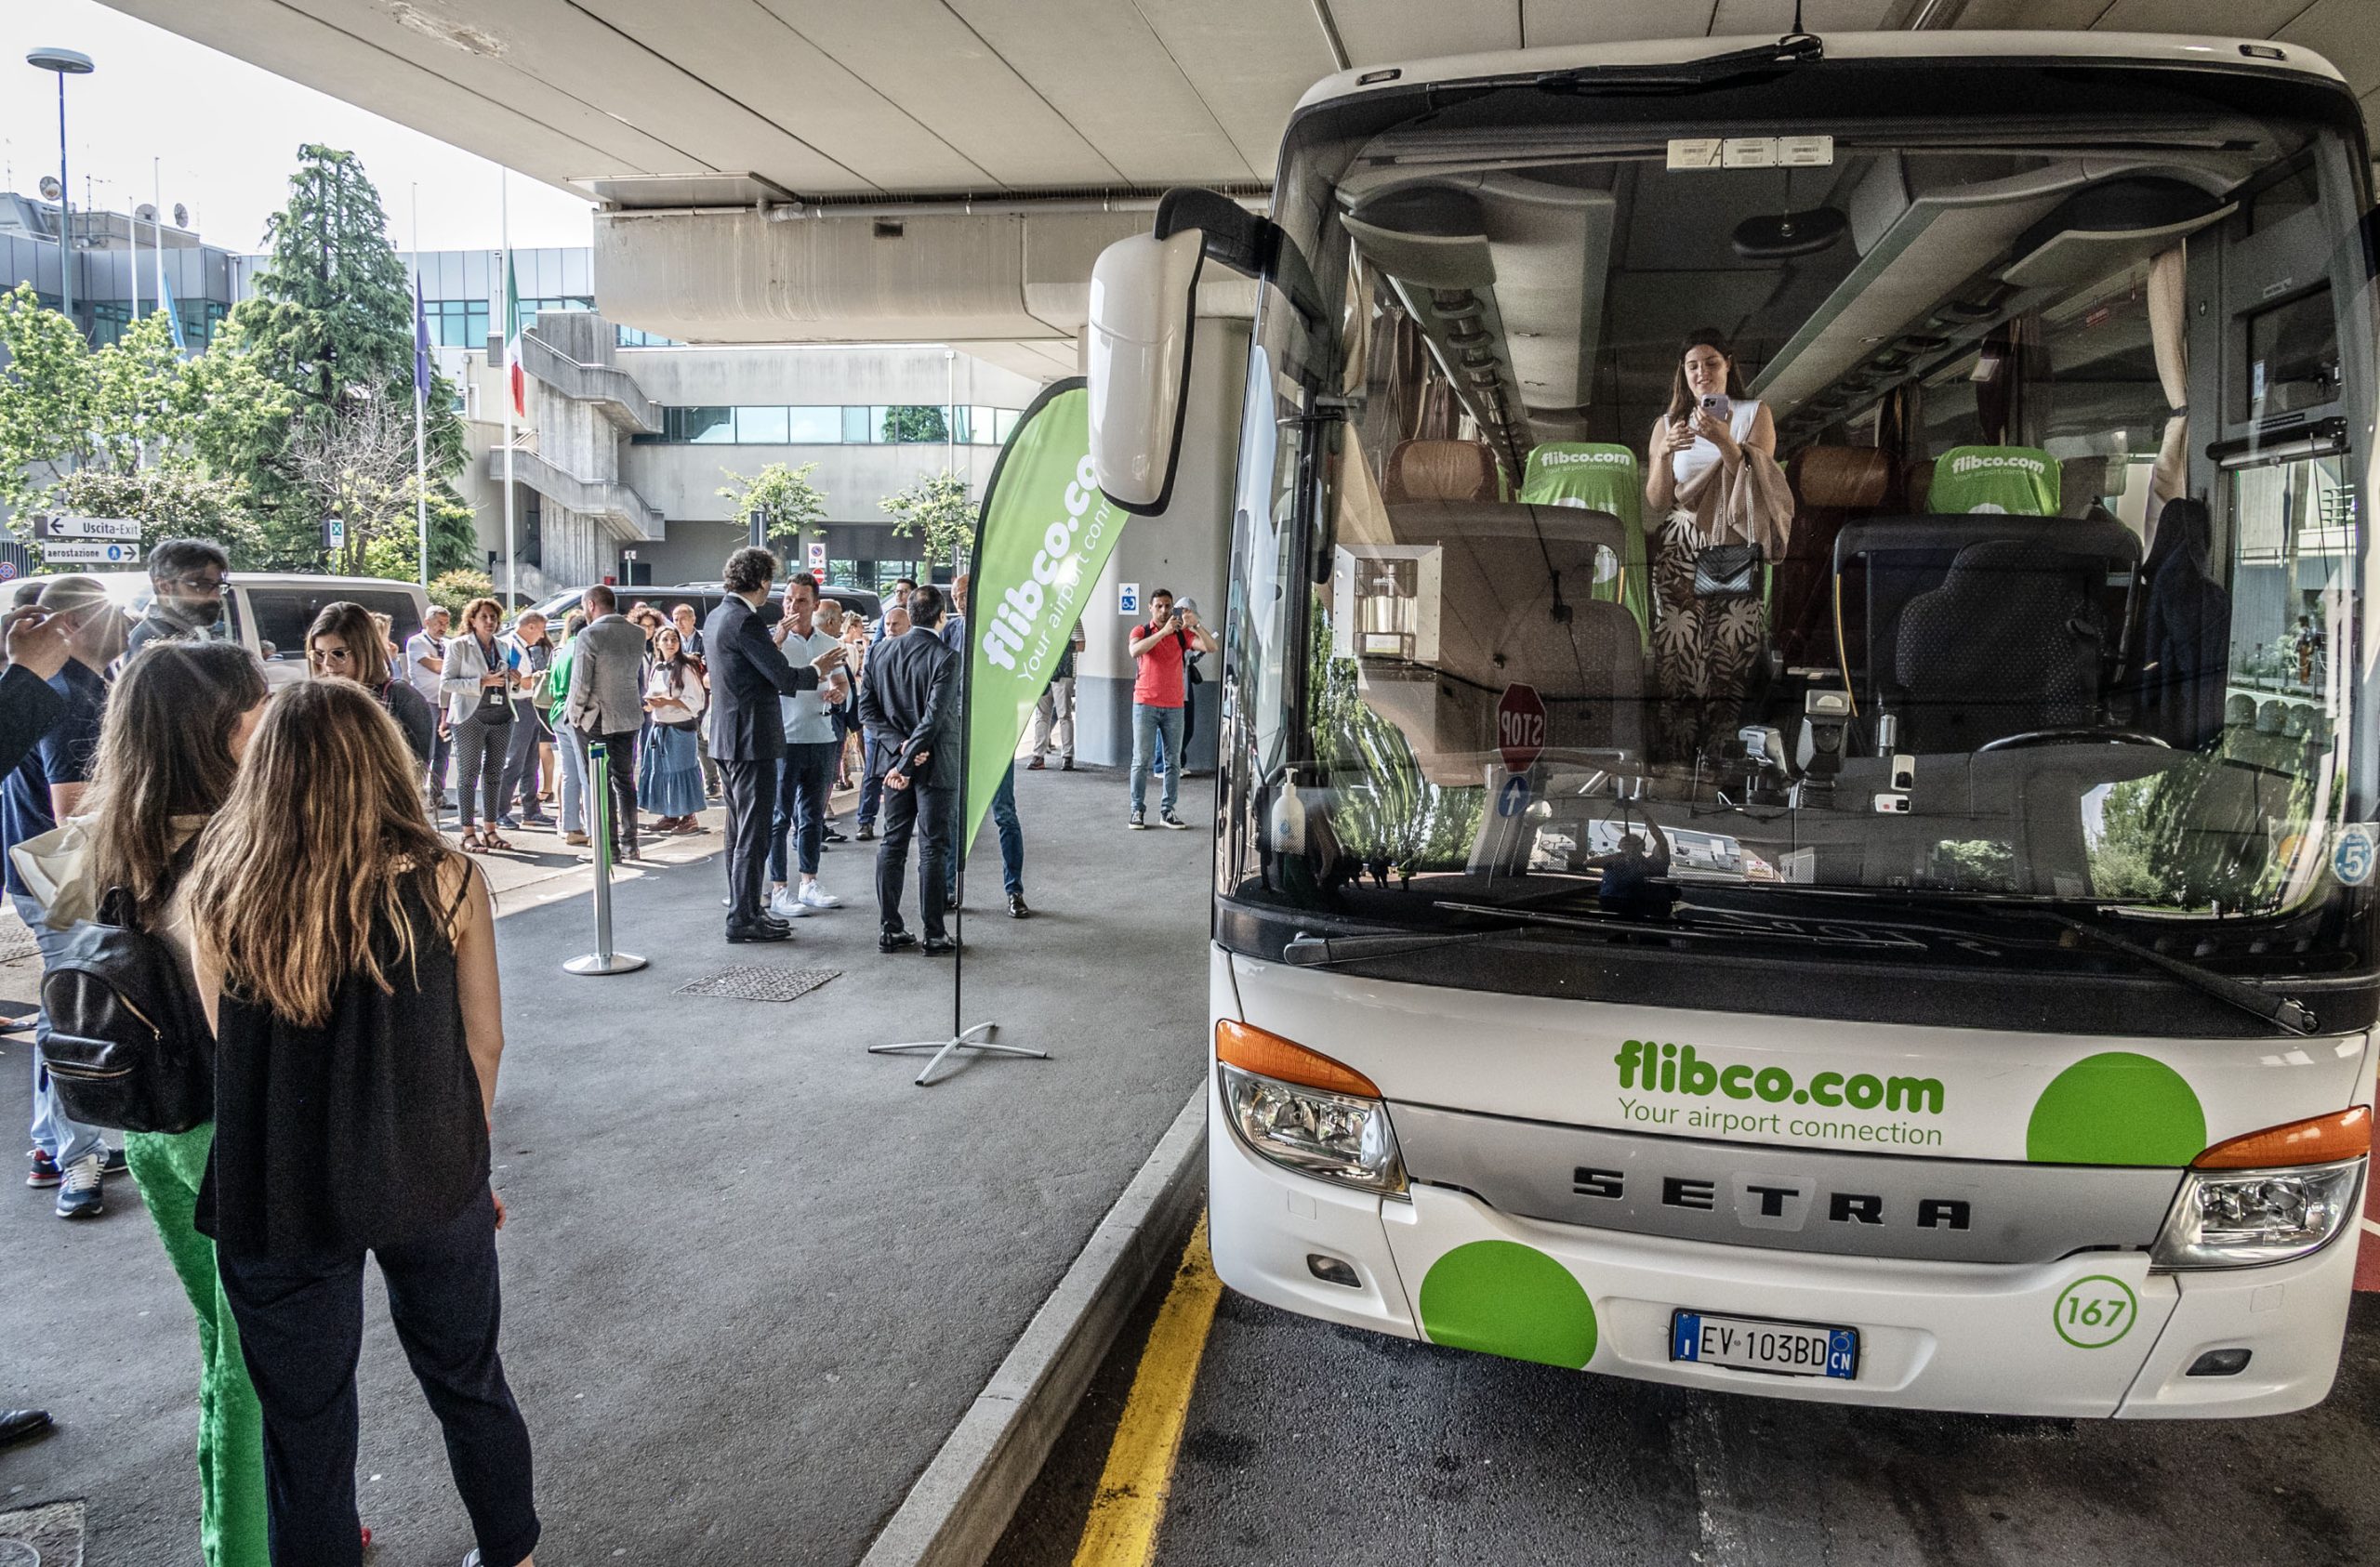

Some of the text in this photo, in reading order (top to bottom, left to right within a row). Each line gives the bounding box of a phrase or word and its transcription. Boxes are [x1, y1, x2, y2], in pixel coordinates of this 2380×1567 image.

[1540, 451, 1631, 467] flibco.com
[1952, 454, 2045, 474] flibco.com
[83, 521, 139, 535] Uscita-Exit
[47, 547, 99, 558] aerostazione
[1017, 629, 1051, 681] Your
[1049, 551, 1090, 628] airport
[2344, 846, 2363, 876] 5
[1614, 1039, 1945, 1114] flibco.com
[1618, 1097, 1942, 1146] Your airport connection
[1573, 1165, 1971, 1231] SETRA
[2068, 1297, 2127, 1327] 167
[1831, 1351, 1851, 1371] CN
